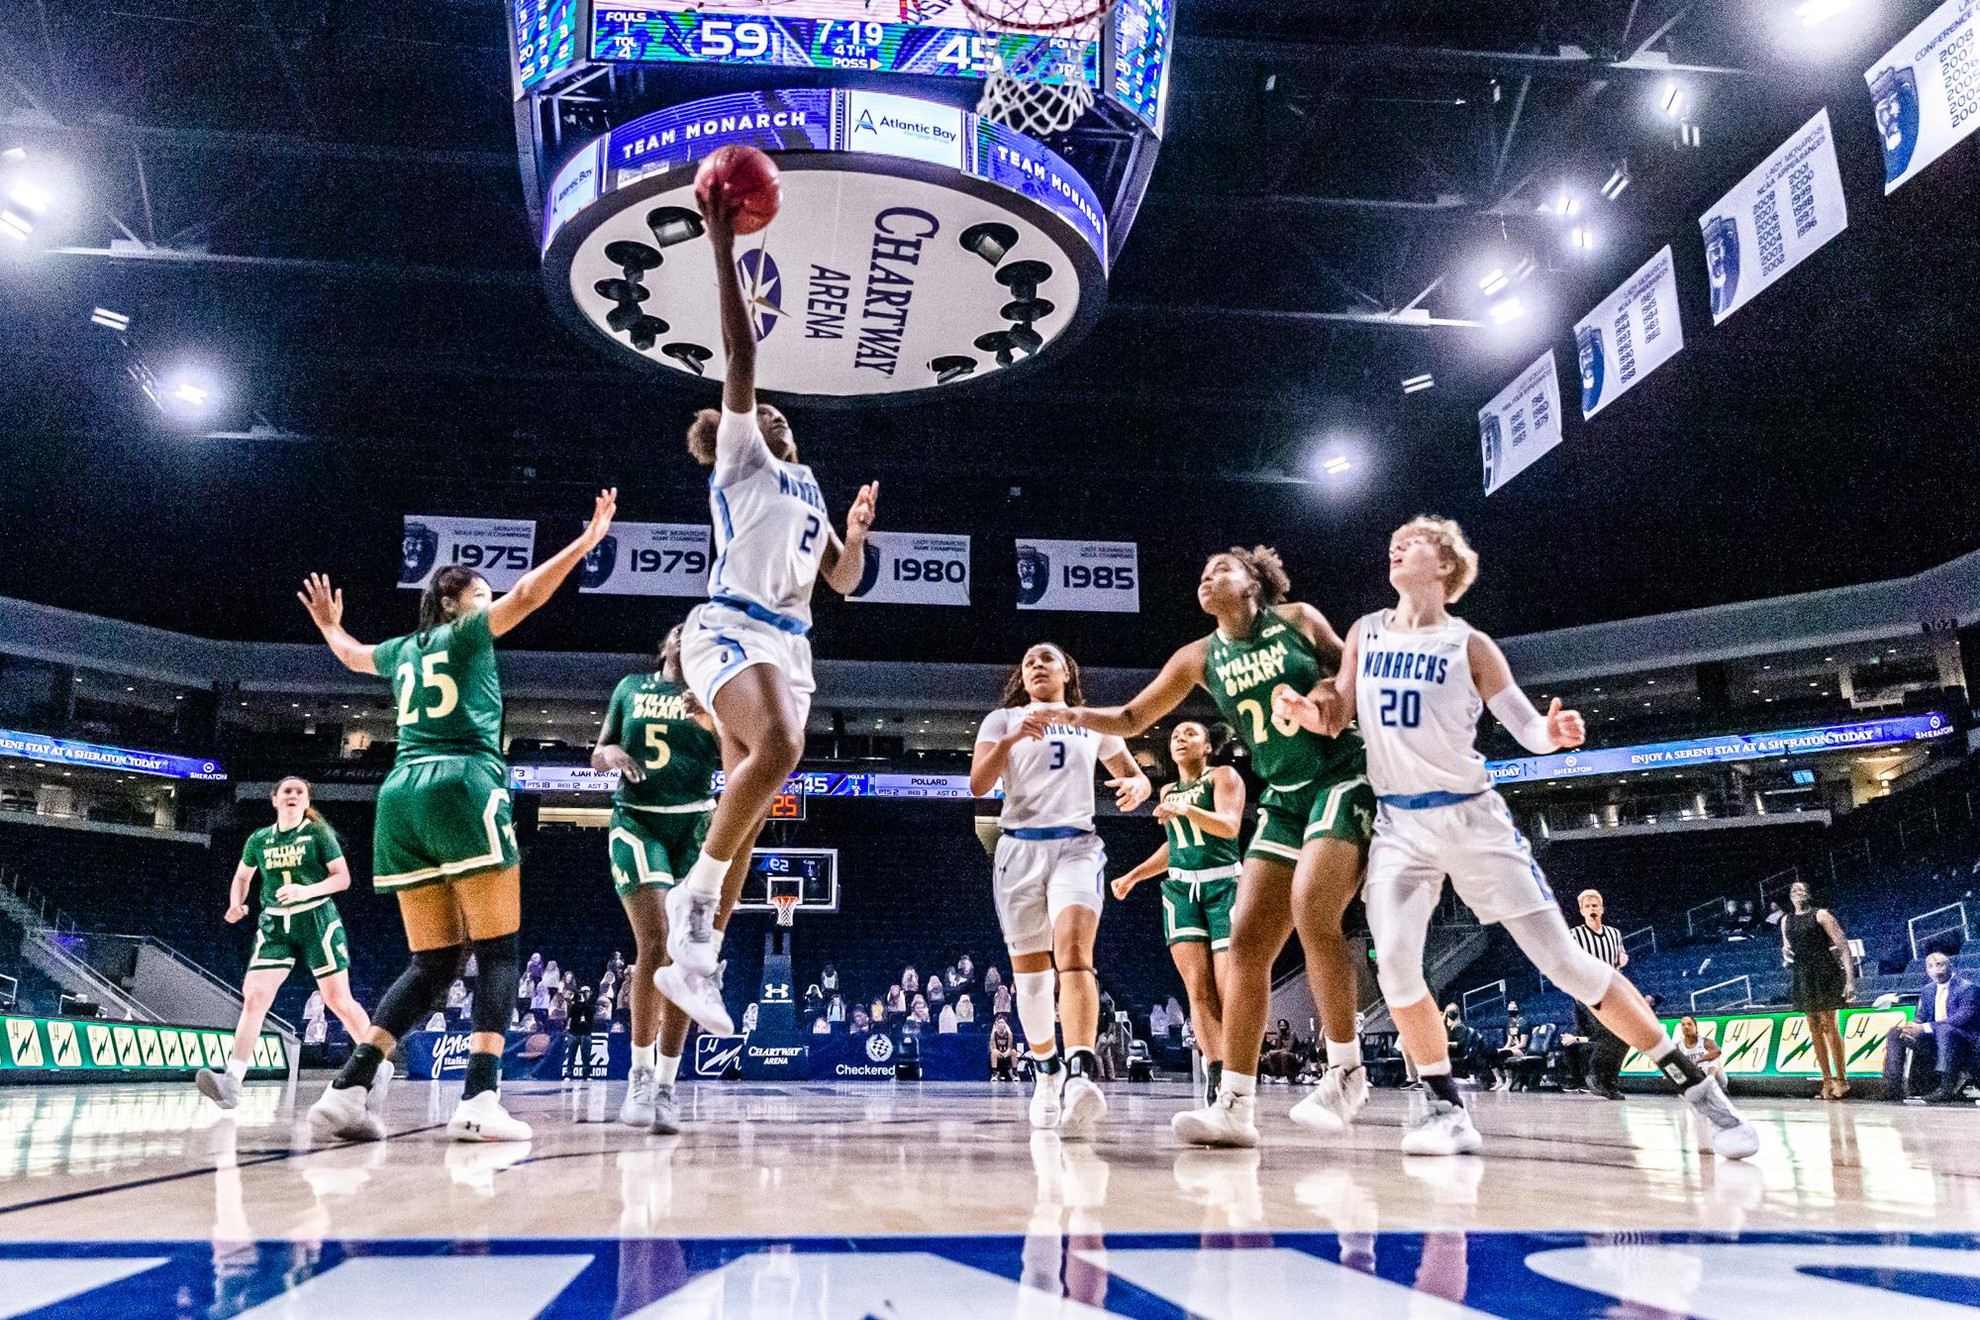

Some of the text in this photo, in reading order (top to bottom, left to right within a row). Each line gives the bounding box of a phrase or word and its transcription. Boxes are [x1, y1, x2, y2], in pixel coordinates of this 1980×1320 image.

[605, 12, 647, 22] FOULS
[614, 37, 637, 47] TOL
[700, 20, 768, 57] 59
[816, 19, 883, 46] 7:19
[1915, 9, 1972, 61] CONFERENCE
[1939, 28, 1973, 63] 2008
[618, 48, 630, 59] 4
[832, 58, 868, 69] POSS
[834, 44, 865, 57] 4TH
[937, 36, 1002, 72] 45
[1942, 42, 1975, 76] 2007
[1944, 59, 1979, 88] 2006
[1952, 99, 1980, 128] 200
[622, 111, 806, 159] TEAM MONARCH
[880, 115, 931, 135] Atlantic
[932, 125, 957, 143] Bay
[1765, 123, 1823, 180] LADY MONARCHS
[1757, 133, 1825, 197] NCAA APPEARANCES
[1788, 160, 1809, 185] 2001
[998, 145, 1101, 235] TEAM MONARCH
[1790, 168, 1814, 195] 2000
[1752, 189, 1775, 215] 2008
[1753, 199, 1777, 225] 2007
[1755, 210, 1778, 236] 2006
[1757, 220, 1780, 246] 2005
[1758, 230, 1782, 256] 2004
[1760, 241, 1784, 266] 2003
[1762, 251, 1786, 277] 2002
[804, 264, 852, 339] ARENA
[854, 206, 941, 376] CHARTWAY
[799, 514, 820, 553] 2
[452, 544, 528, 569] 1975
[631, 550, 706, 573] 1979
[894, 558, 966, 583] 1980
[1064, 566, 1134, 589] 1985
[1216, 641, 1288, 681] WILLIAM
[1364, 652, 1448, 684] MONARCHS
[396, 651, 458, 726] 25
[634, 694, 686, 706] WILLIA
[1380, 689, 1420, 728] 20
[1915, 725, 1954, 740] SHERATON
[25, 743, 50, 754] STAY
[50, 748, 65, 756] AT
[64, 748, 74, 758] A
[74, 750, 127, 765] SHERATON
[130, 757, 161, 770] TODAY
[645, 724, 671, 769] 5
[1049, 741, 1065, 770] 3
[1631, 753, 1663, 764] ENJOY
[1664, 751, 1674, 760] A
[1674, 748, 1713, 760] SERENE
[1714, 744, 1740, 755] STAY
[1742, 742, 1756, 752] AT
[1758, 740, 1768, 750] A
[1833, 730, 1874, 742] TODAY
[190, 772, 228, 780] SHERATON
[805, 776, 829, 792] 45
[911, 778, 948, 786] POLLARD
[1488, 767, 1520, 778] TODAY
[1554, 766, 1592, 776] SHERATON
[772, 795, 798, 816] 25
[1169, 816, 1205, 849] 11
[263, 845, 306, 859] WILLIAM
[444, 1056, 470, 1065] Italia
[748, 1046, 802, 1056] CHARTWAY
[588, 1067, 608, 1076] ION
[836, 1064, 896, 1075] Checkered
